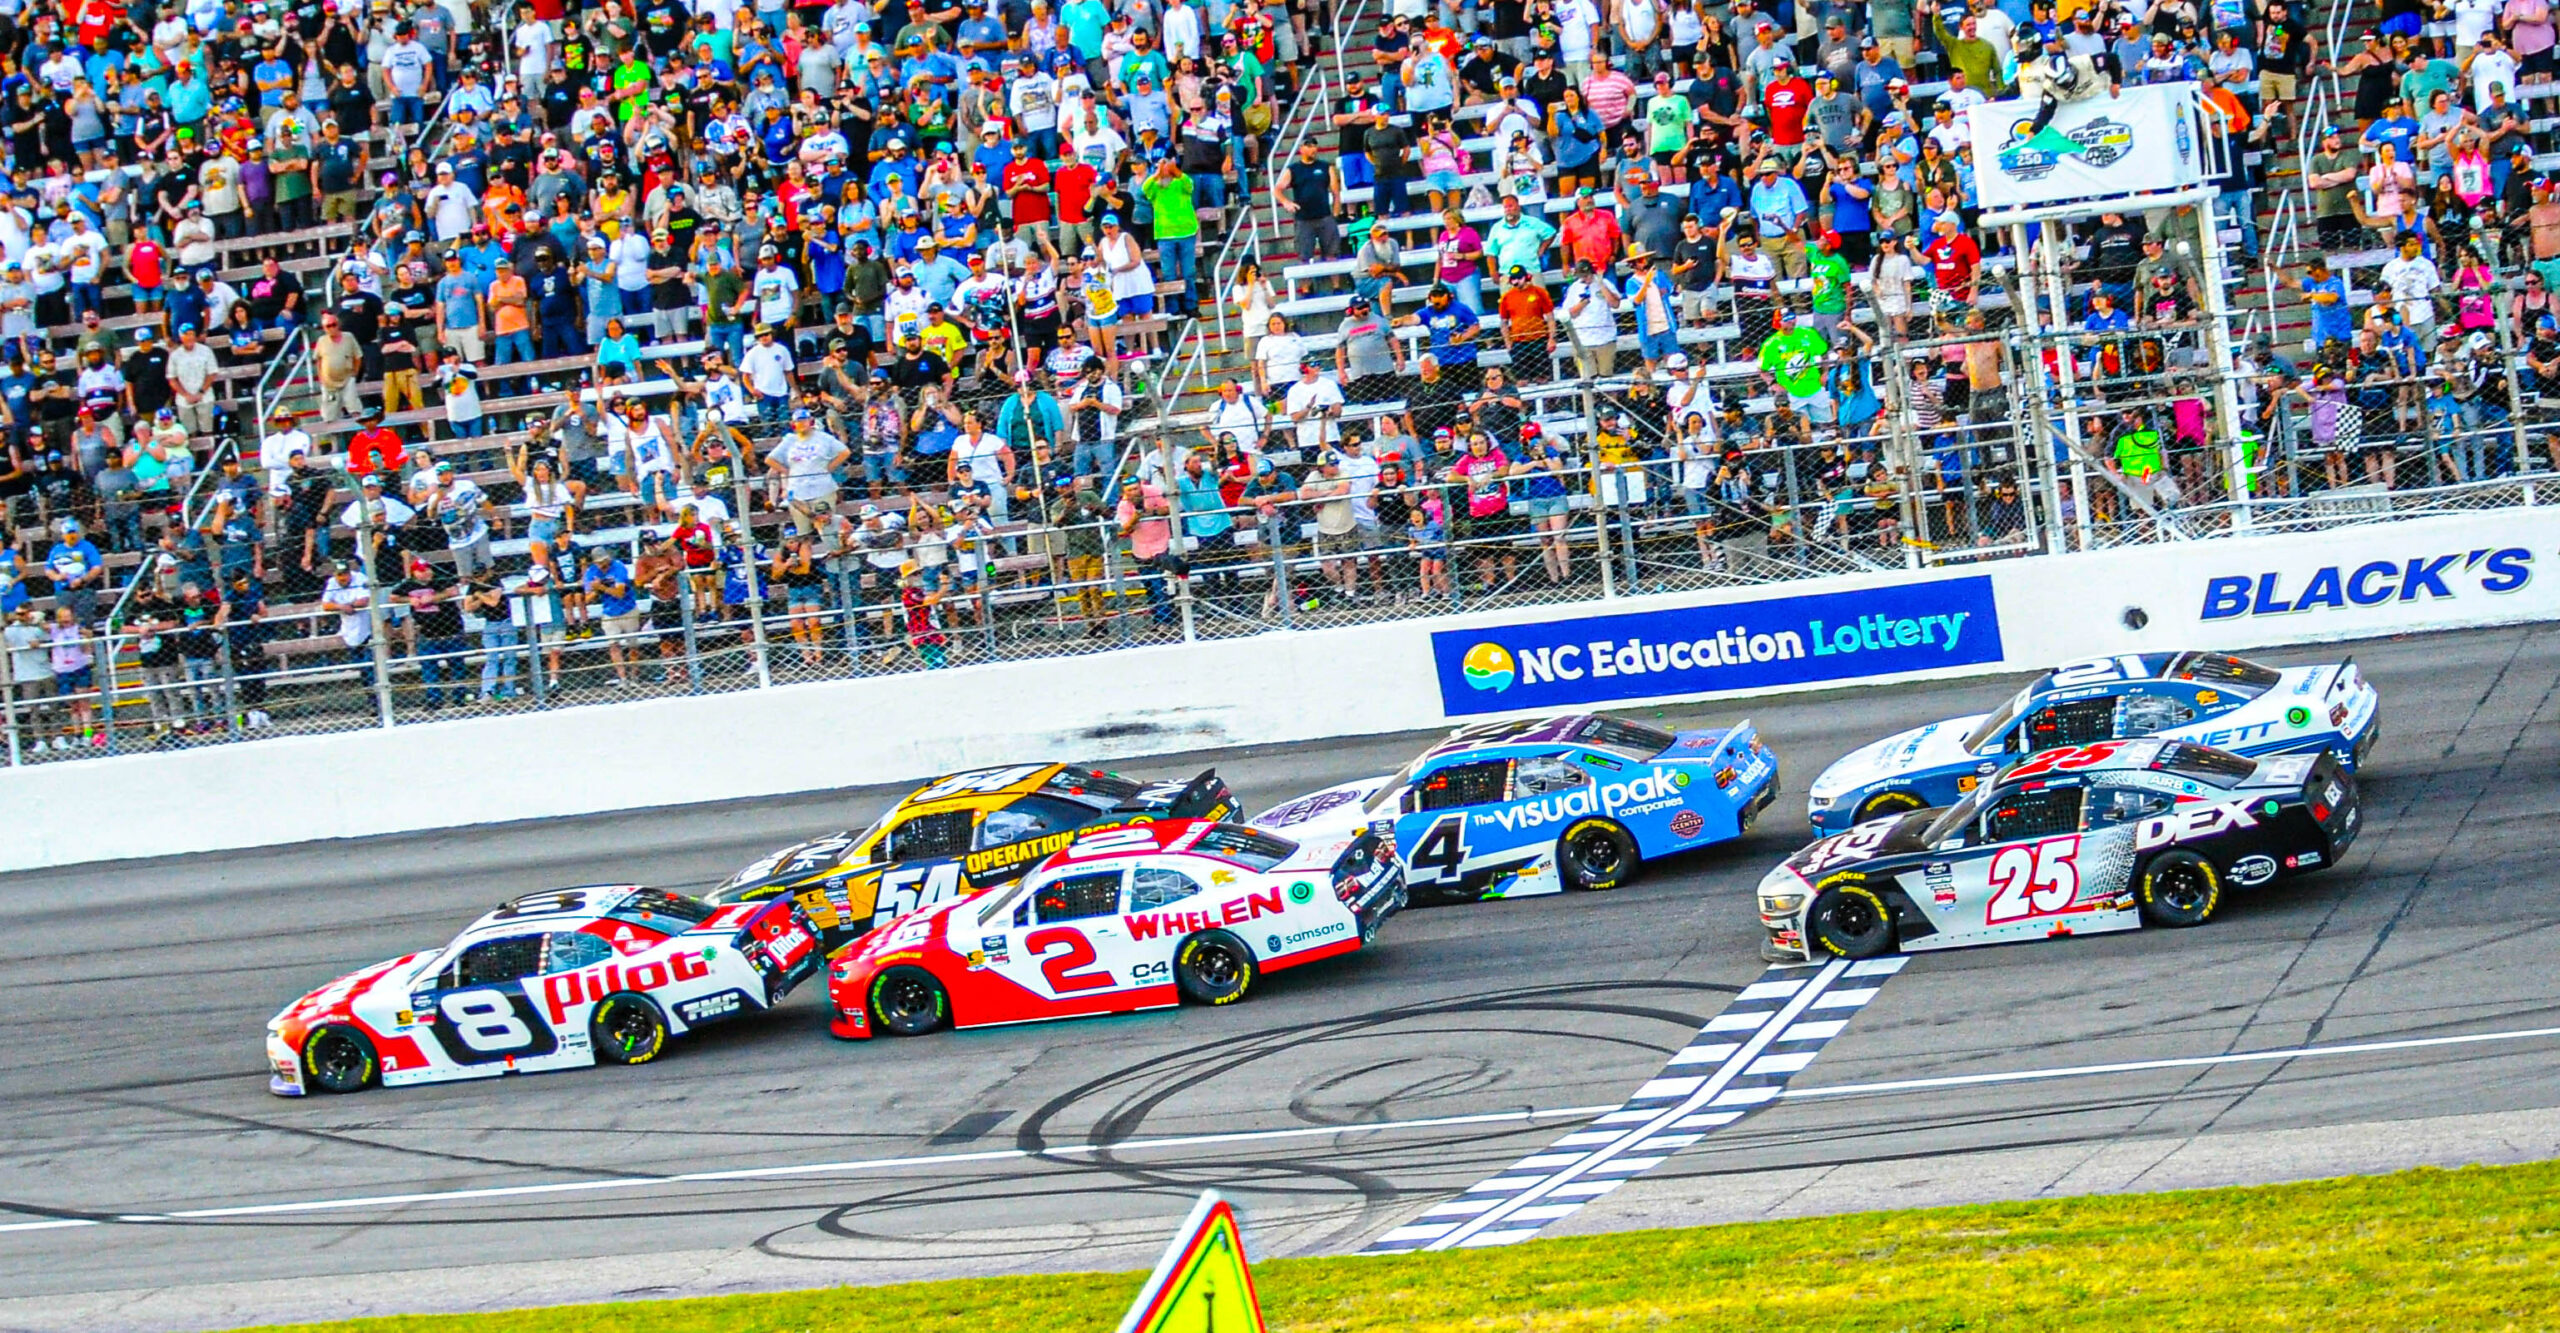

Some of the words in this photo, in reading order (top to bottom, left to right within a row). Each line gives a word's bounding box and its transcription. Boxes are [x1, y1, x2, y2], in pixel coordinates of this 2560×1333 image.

[2015, 153, 2043, 166] 250
[2200, 547, 2534, 621] BLACK'S
[1520, 645, 1585, 684] NC
[1591, 626, 1805, 677] Education
[1809, 611, 1966, 657] Lottery
[912, 764, 1051, 802] 54
[2000, 740, 2130, 783] 25
[1473, 813, 1495, 827] The
[1619, 795, 1684, 818] companies
[1670, 817, 1705, 832] SCENTSY
[2135, 795, 2260, 852] DEX
[966, 829, 1076, 875] OPERATION
[1408, 812, 1472, 883] 4
[873, 862, 962, 928] 54
[1816, 870, 1867, 890] GOODYEAR
[1986, 834, 2082, 926] 25
[1123, 886, 1285, 942] WHELEN
[1285, 922, 1346, 945] samsara
[1025, 926, 1119, 994] 2
[1132, 960, 1169, 979] C4
[440, 988, 533, 1052] 8
[682, 991, 740, 1021] TMC
